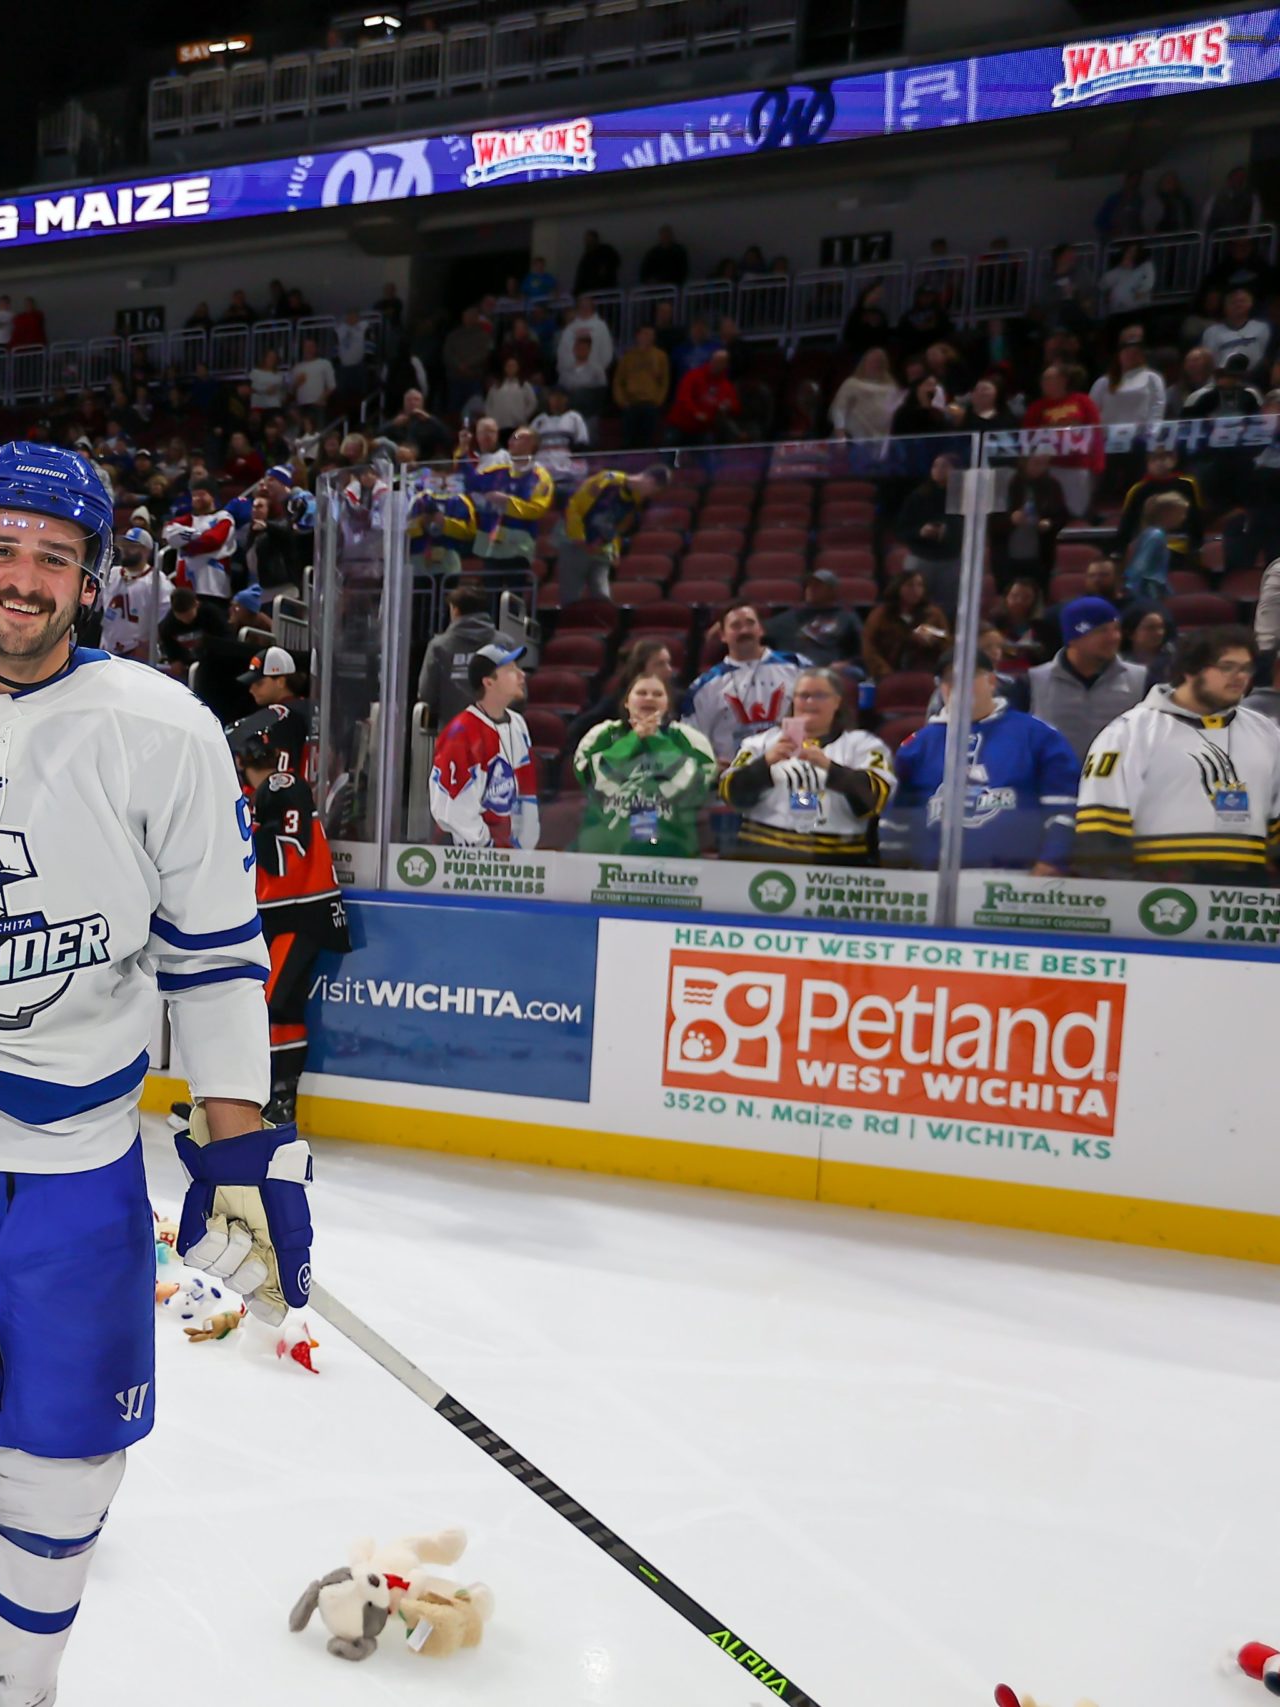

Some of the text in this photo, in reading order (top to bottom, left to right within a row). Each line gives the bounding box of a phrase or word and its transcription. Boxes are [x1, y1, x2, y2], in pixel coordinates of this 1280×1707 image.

[34, 176, 212, 236] MAIZE
[15, 464, 68, 480] WARRIOR
[284, 809, 300, 834] 3
[443, 847, 511, 863] Wichita
[442, 861, 546, 880] FURNITURE
[597, 862, 699, 889] Furniture
[805, 871, 886, 888] Wichita
[452, 877, 546, 895] MATTRESS
[805, 886, 929, 908] FURNITURE
[981, 880, 1107, 910] Furniture
[816, 903, 928, 924] MATTRESS
[674, 927, 1127, 978] HEAD OUT WEST FOR THE BEST!
[797, 982, 1112, 1081] Petland
[796, 1058, 1109, 1119] WEST WICHITA
[663, 1090, 727, 1115] 3520
[736, 1098, 761, 1120] N.
[771, 1102, 853, 1130] Maize
[863, 1113, 899, 1136] Rd
[925, 1121, 1061, 1158] WICHITA,
[1071, 1137, 1112, 1160] KS
[706, 1629, 789, 1697] ALPHA
